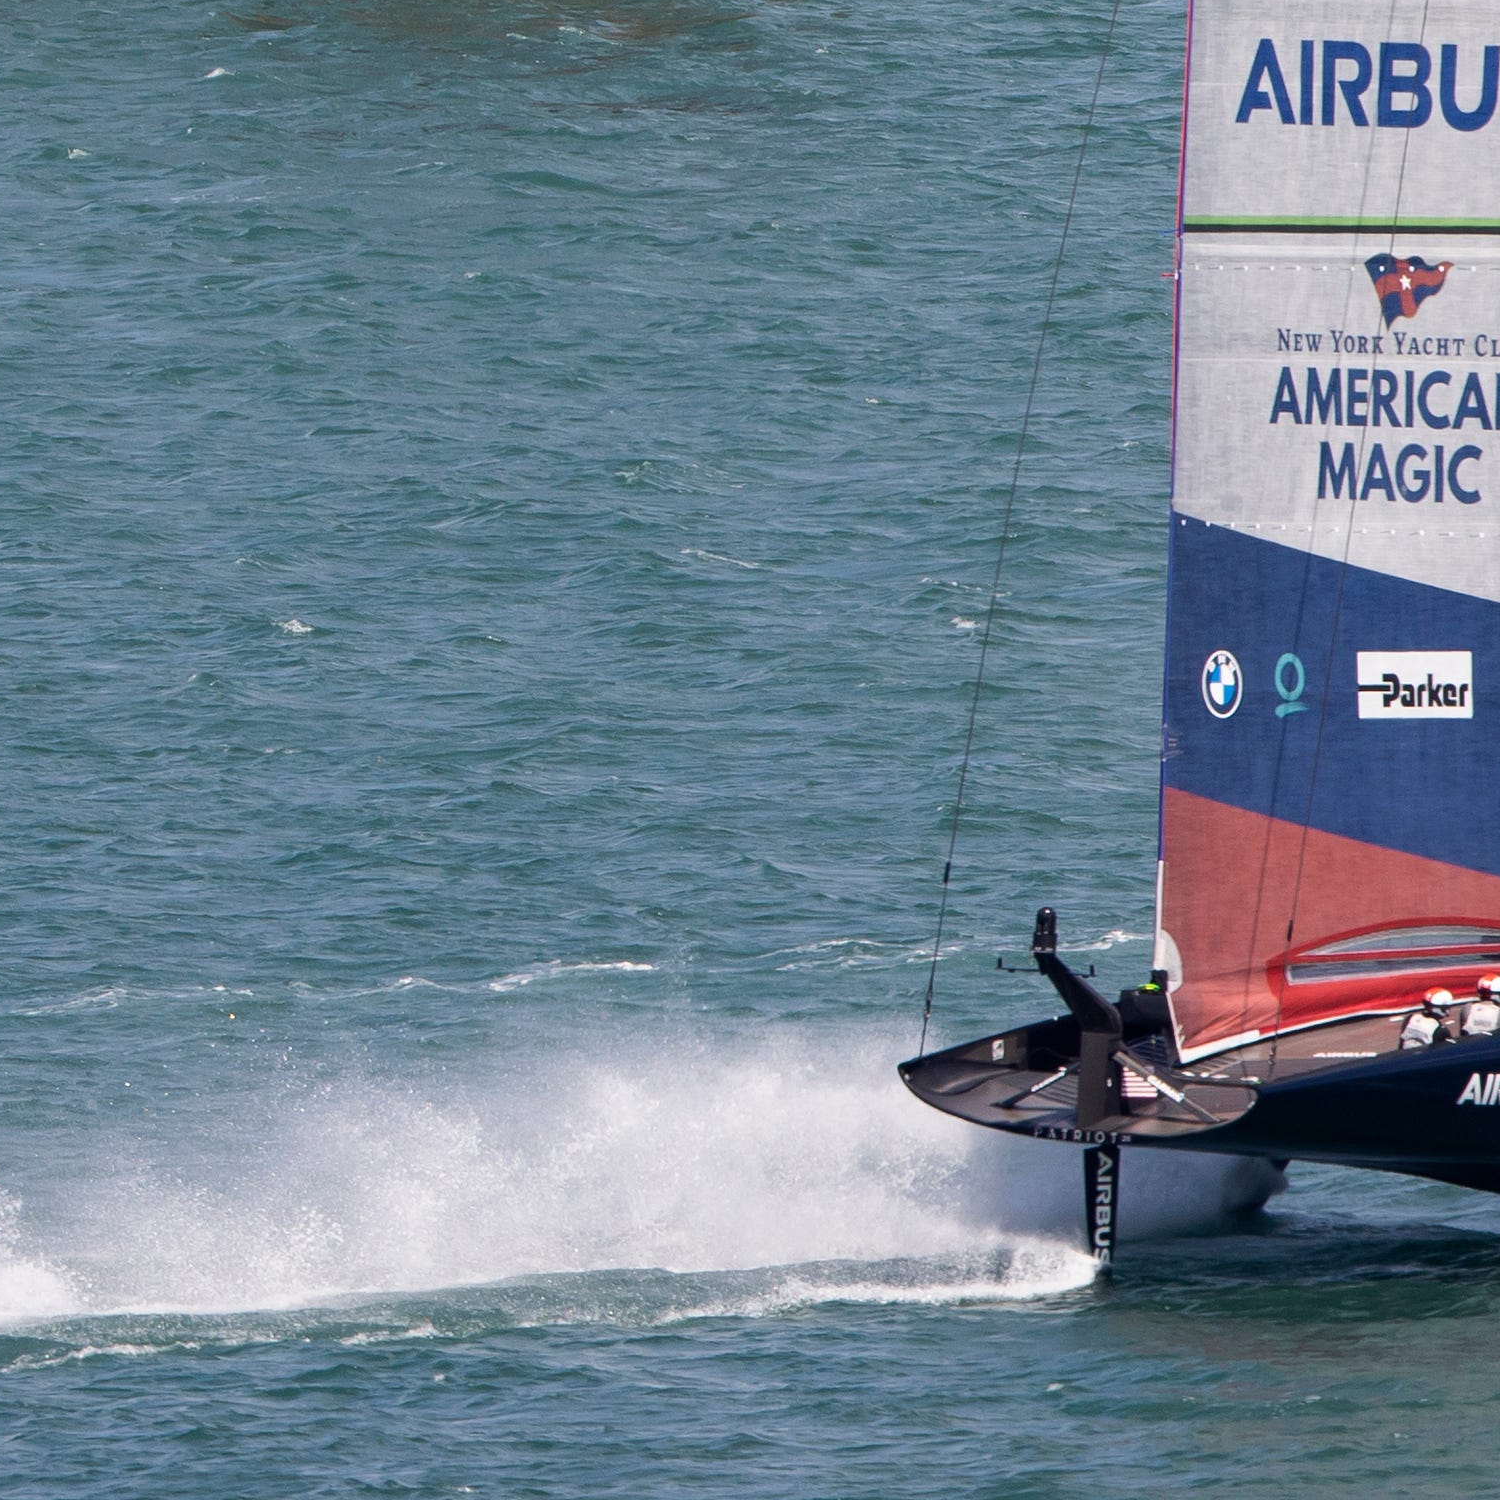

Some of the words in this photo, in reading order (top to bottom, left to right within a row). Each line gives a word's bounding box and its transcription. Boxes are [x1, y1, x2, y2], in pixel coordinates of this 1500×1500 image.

[1317, 441, 1483, 504] MAGIC
[1380, 673, 1469, 708] Parker
[1034, 1127, 1119, 1145] PATRIOT
[1094, 1151, 1114, 1266] AIRBUS
